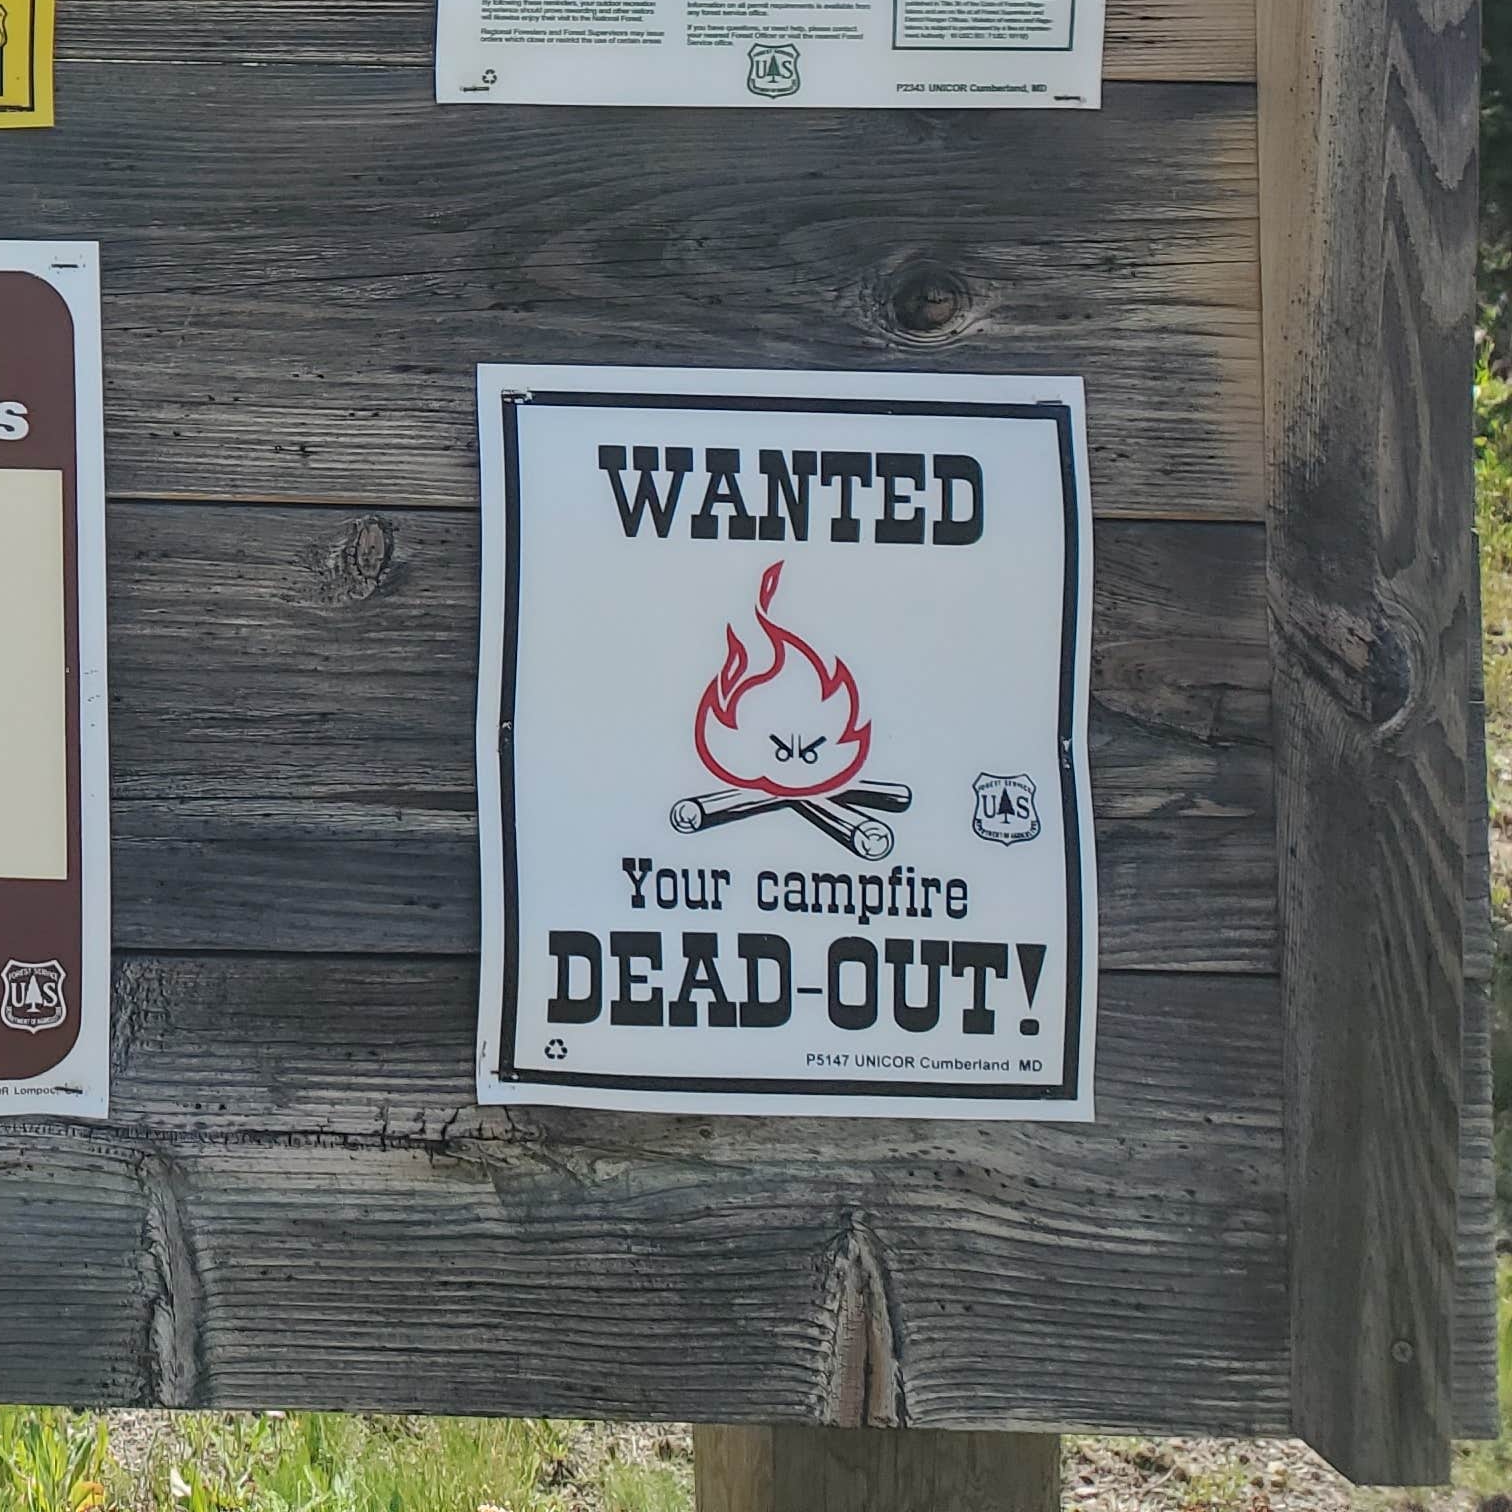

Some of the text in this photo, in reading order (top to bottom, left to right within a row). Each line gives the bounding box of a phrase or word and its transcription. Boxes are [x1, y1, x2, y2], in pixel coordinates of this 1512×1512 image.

[896, 83, 926, 92] P2343
[928, 83, 968, 93] UNICOR
[1031, 83, 1048, 93] MD
[598, 444, 984, 546] WANTED
[621, 857, 968, 926] Your campfire
[546, 930, 1047, 1036] DEAD-OUT!
[806, 1053, 1043, 1072] P5147 UNICOR Cumberland MD
